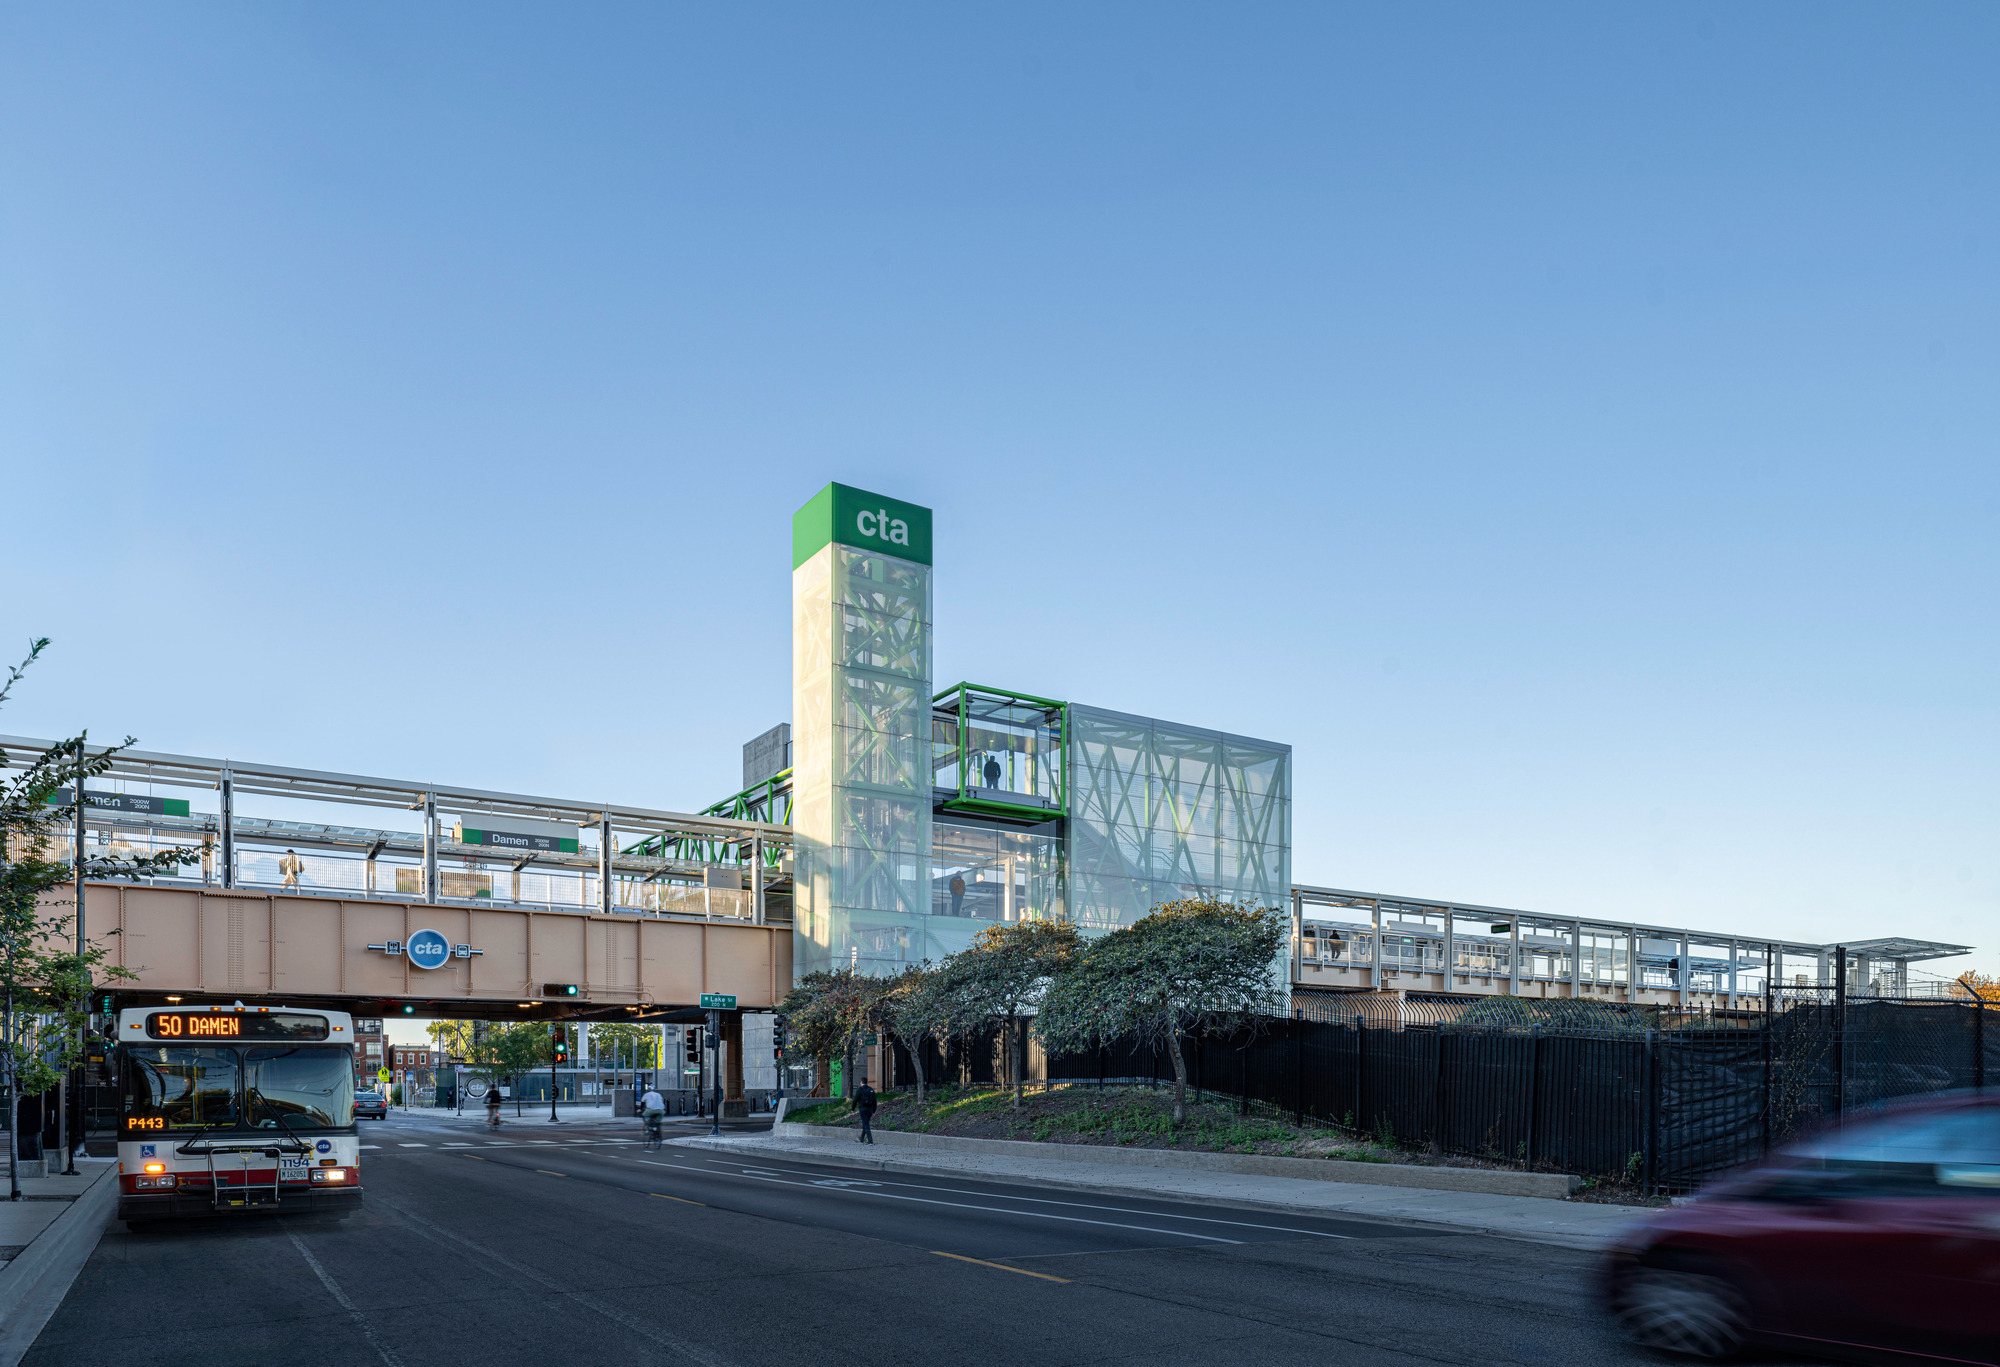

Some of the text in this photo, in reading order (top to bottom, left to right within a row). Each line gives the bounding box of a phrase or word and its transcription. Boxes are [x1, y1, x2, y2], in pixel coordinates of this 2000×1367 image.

[857, 508, 909, 546] cta
[492, 833, 529, 846] Damen
[414, 941, 443, 955] cta
[710, 995, 726, 1003] Lake
[158, 1015, 239, 1036] 50 DAMEN
[128, 1117, 164, 1130] P443
[281, 1159, 310, 1168] 1194
